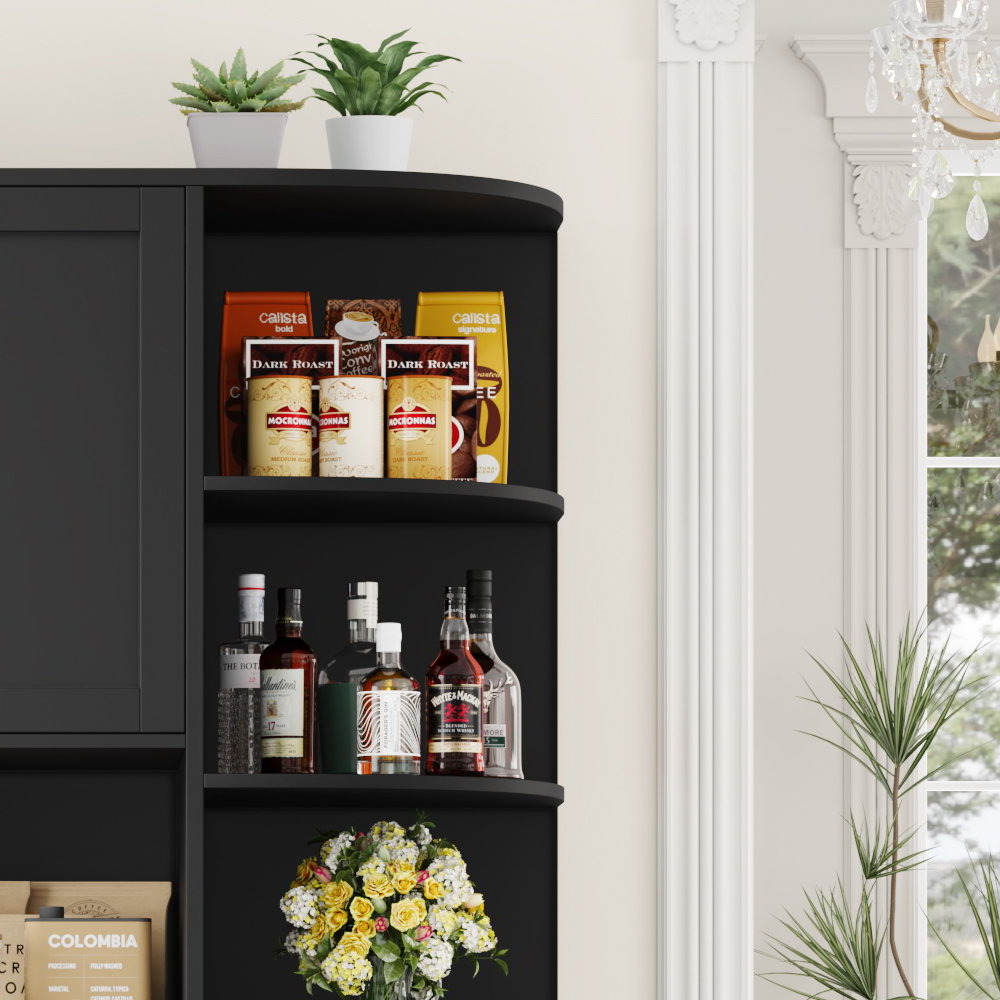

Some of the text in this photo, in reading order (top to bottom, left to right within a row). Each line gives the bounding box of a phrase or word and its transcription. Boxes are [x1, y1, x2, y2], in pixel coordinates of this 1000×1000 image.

[275, 325, 293, 333] bold
[457, 325, 497, 334] signature
[252, 359, 334, 369] DARK ROAST
[387, 359, 469, 369] DARK ROAST
[223, 662, 239, 671] THE
[267, 721, 276, 731] 17
[47, 934, 139, 948] COLOMBIA
